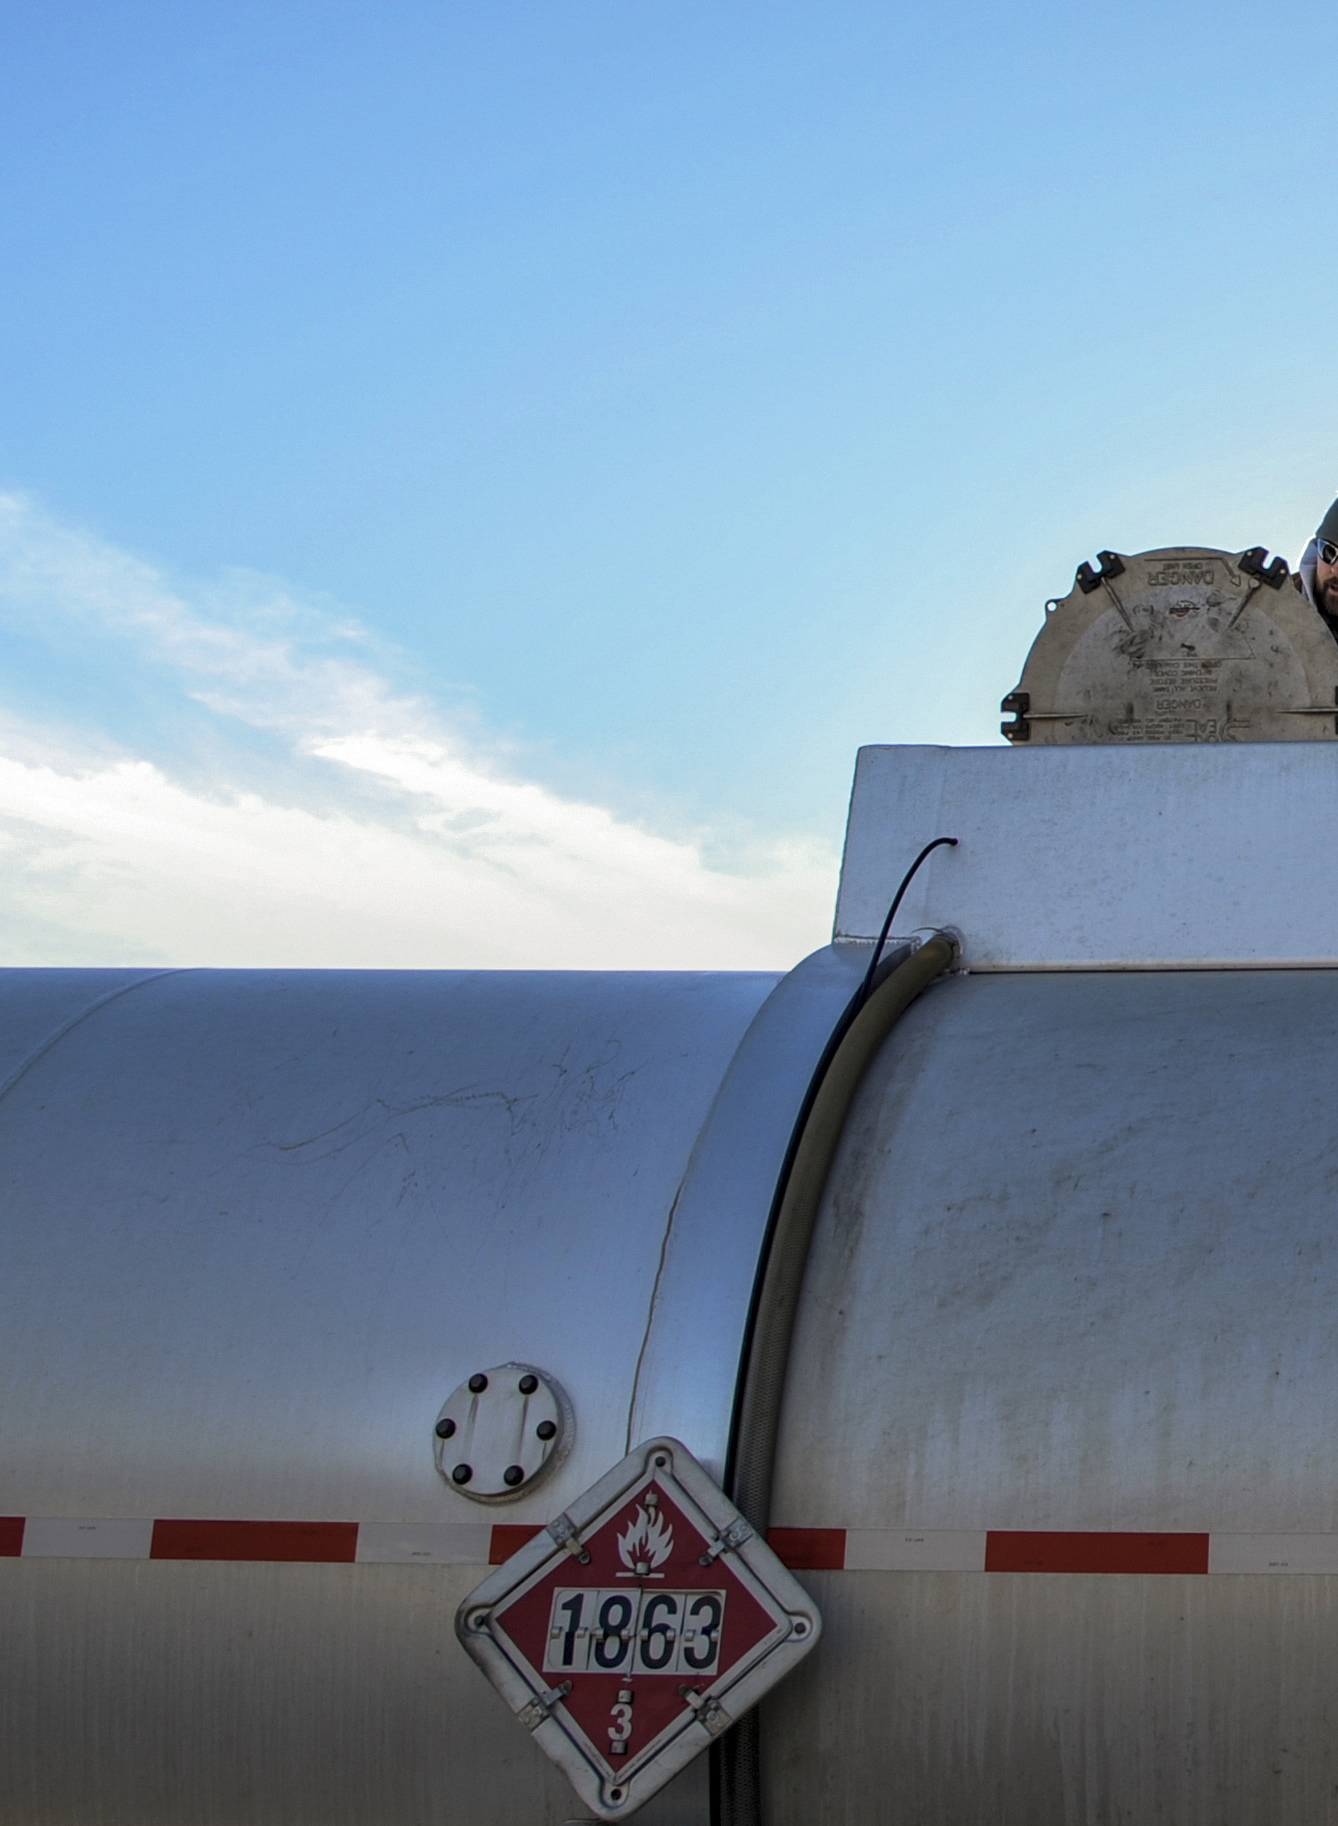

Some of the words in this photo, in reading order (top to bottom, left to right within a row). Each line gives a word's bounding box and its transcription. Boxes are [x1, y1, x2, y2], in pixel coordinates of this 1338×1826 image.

[1147, 571, 1214, 586] DANGER
[1156, 699, 1200, 710] DANGER
[560, 1593, 722, 1670] 1863
[607, 1703, 633, 1740] 3
